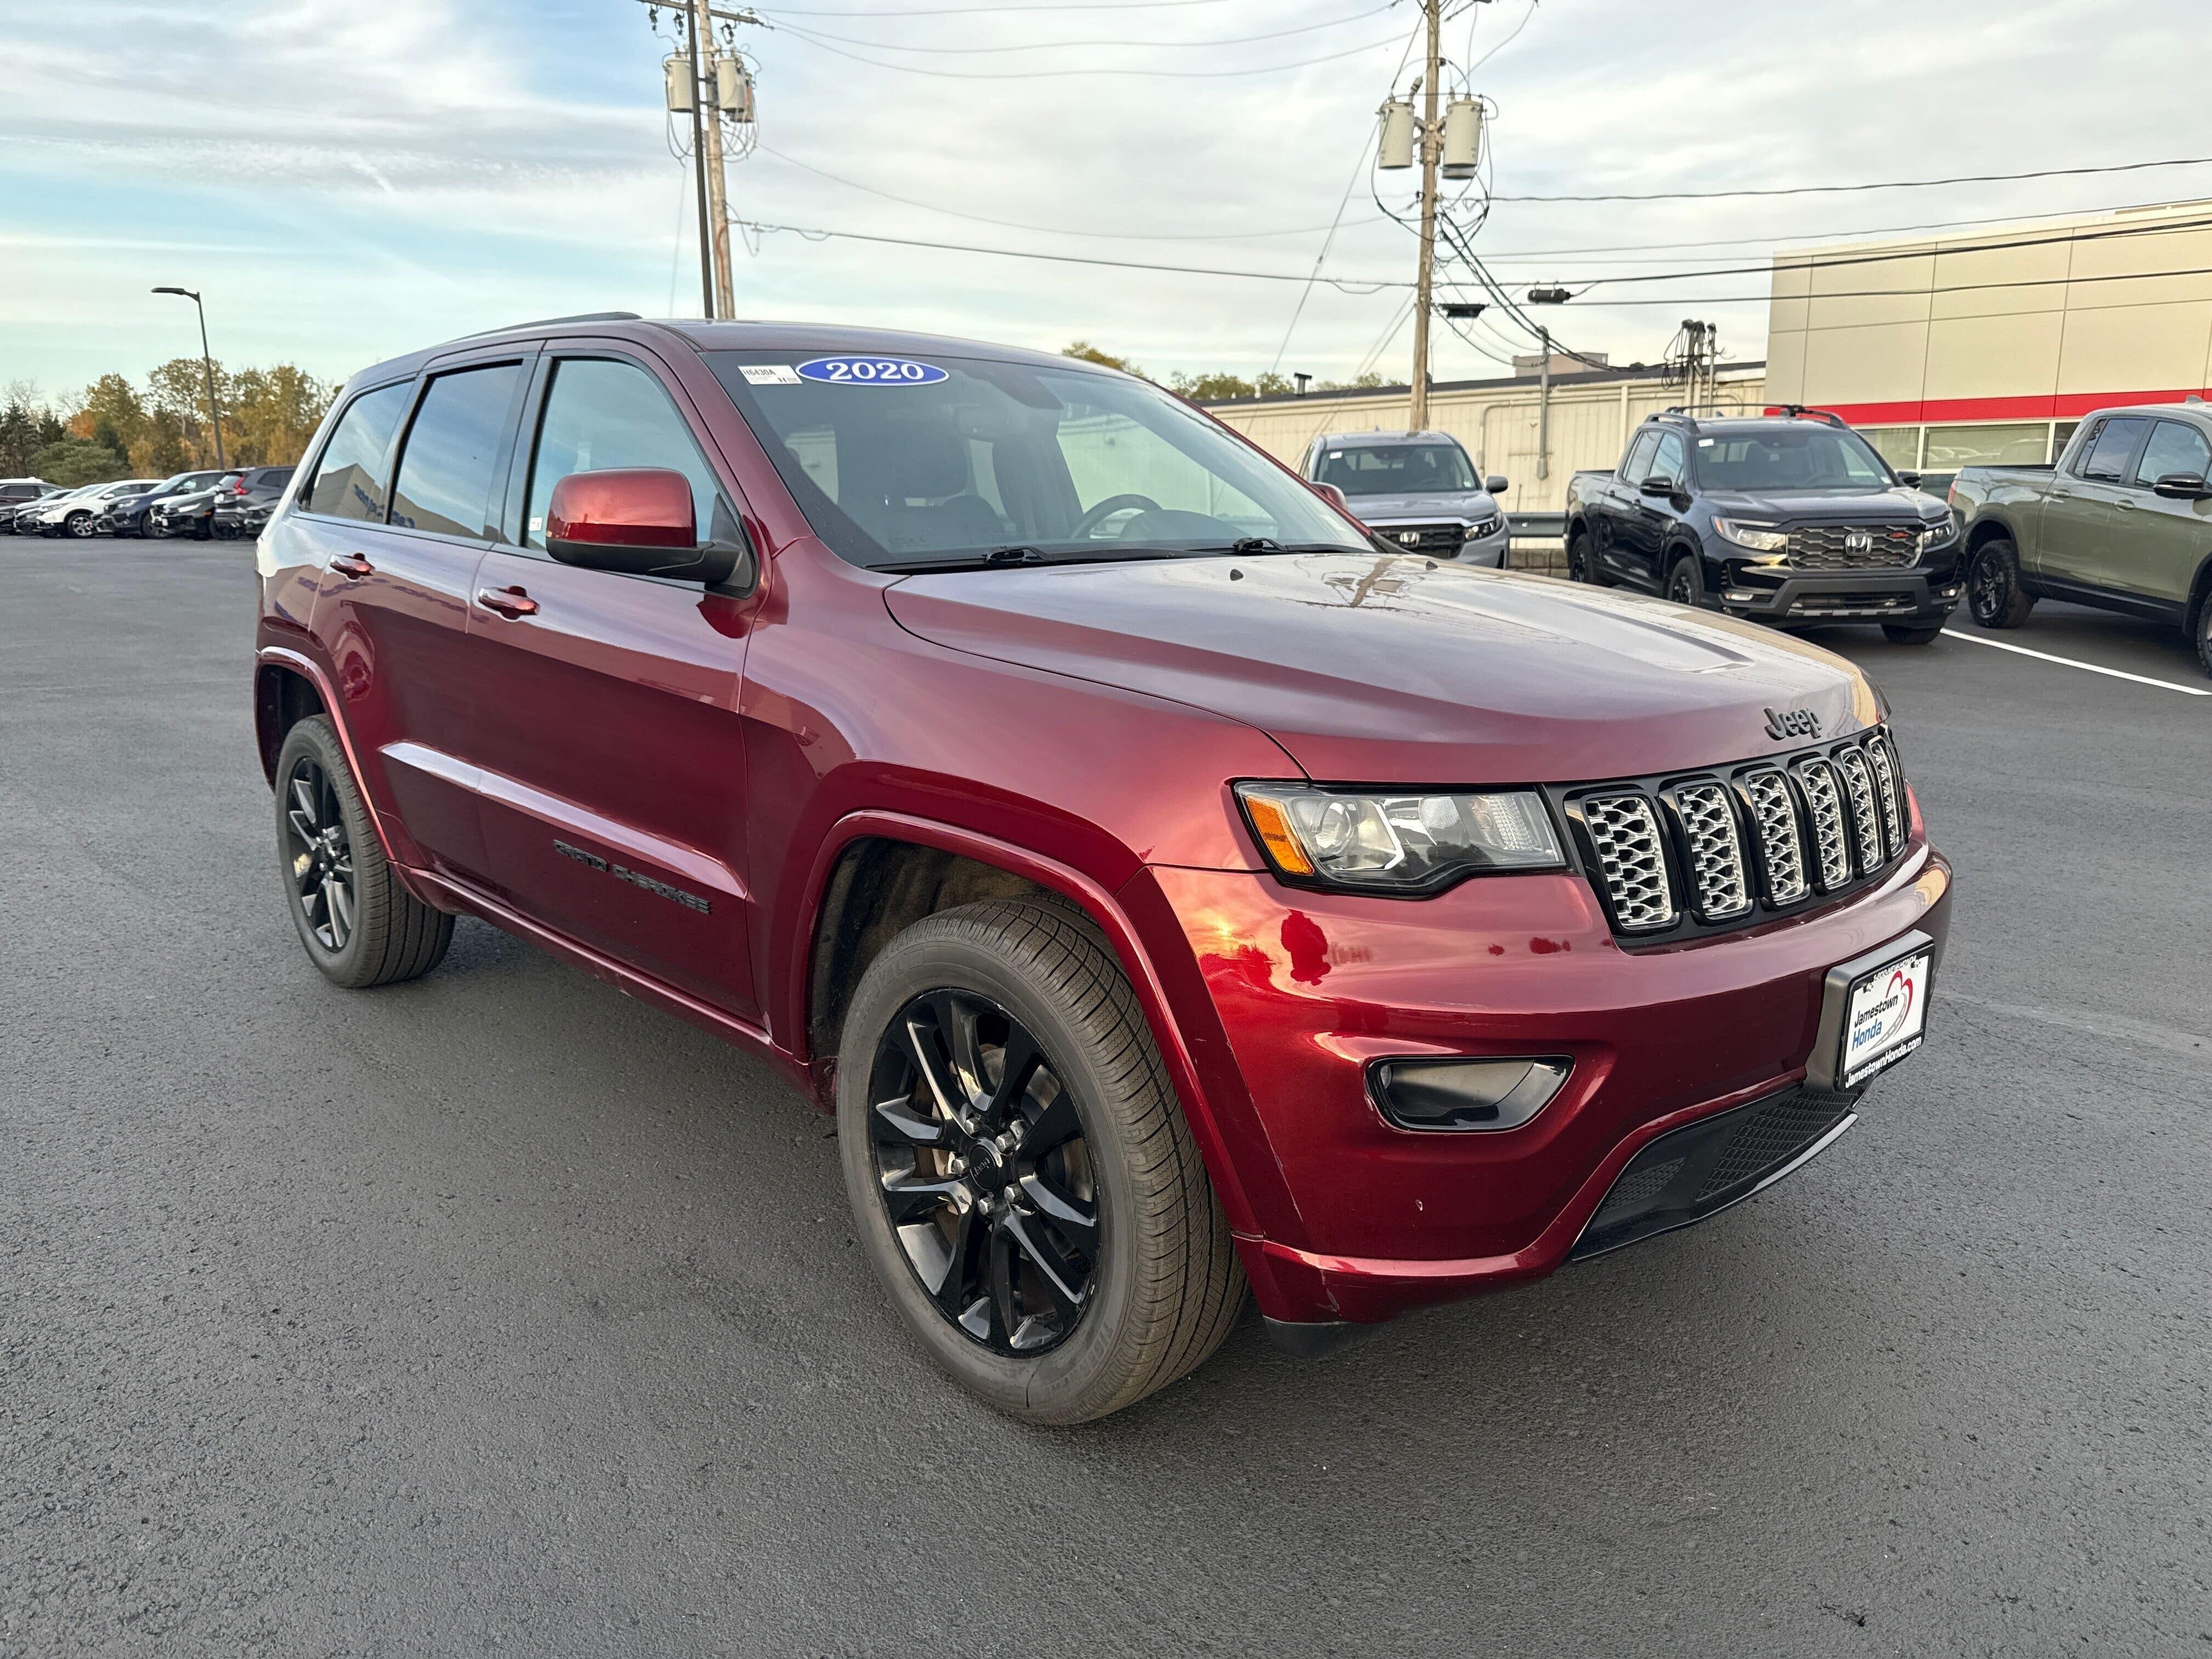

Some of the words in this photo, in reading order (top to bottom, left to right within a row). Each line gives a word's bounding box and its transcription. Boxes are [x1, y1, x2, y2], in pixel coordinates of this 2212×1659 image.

[826, 362, 924, 380] 2020
[1764, 707, 1822, 741] Jeep
[553, 839, 609, 872] GRAND
[612, 864, 712, 915] CHEROKEE
[1854, 995, 1898, 1028] Jamestown
[1852, 1019, 1882, 1051] Honda
[1846, 1036, 1922, 1088] JamestownHonda.com
